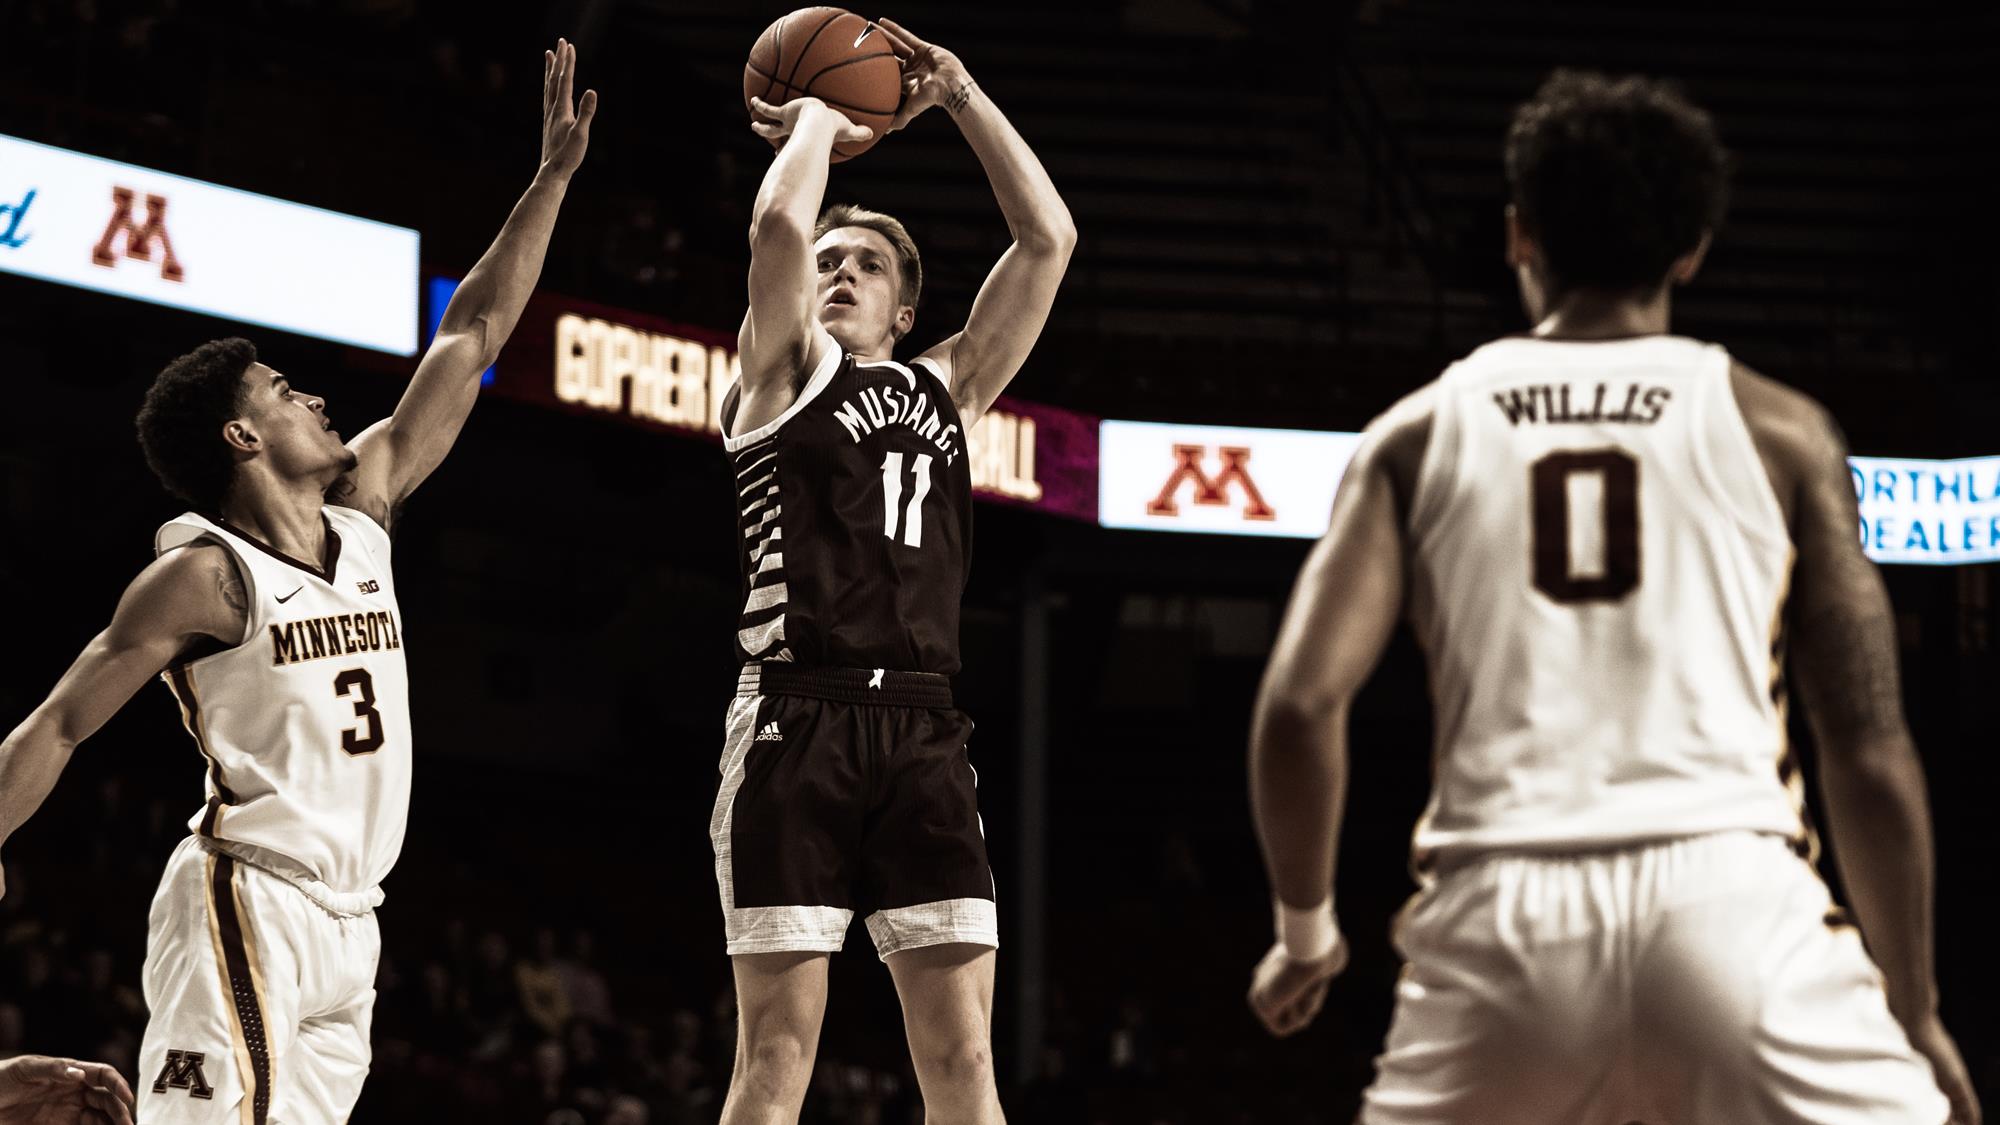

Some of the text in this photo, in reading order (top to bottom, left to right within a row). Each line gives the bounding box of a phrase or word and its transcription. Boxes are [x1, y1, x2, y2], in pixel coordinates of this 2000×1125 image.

[555, 313, 708, 432] GOPHER
[1492, 383, 1672, 427] WILLIS
[880, 451, 933, 548] 11
[1528, 445, 1643, 607] 0
[1851, 465, 2000, 504] RTHL
[268, 610, 401, 667] MINNESOTA
[333, 667, 386, 758] 3
